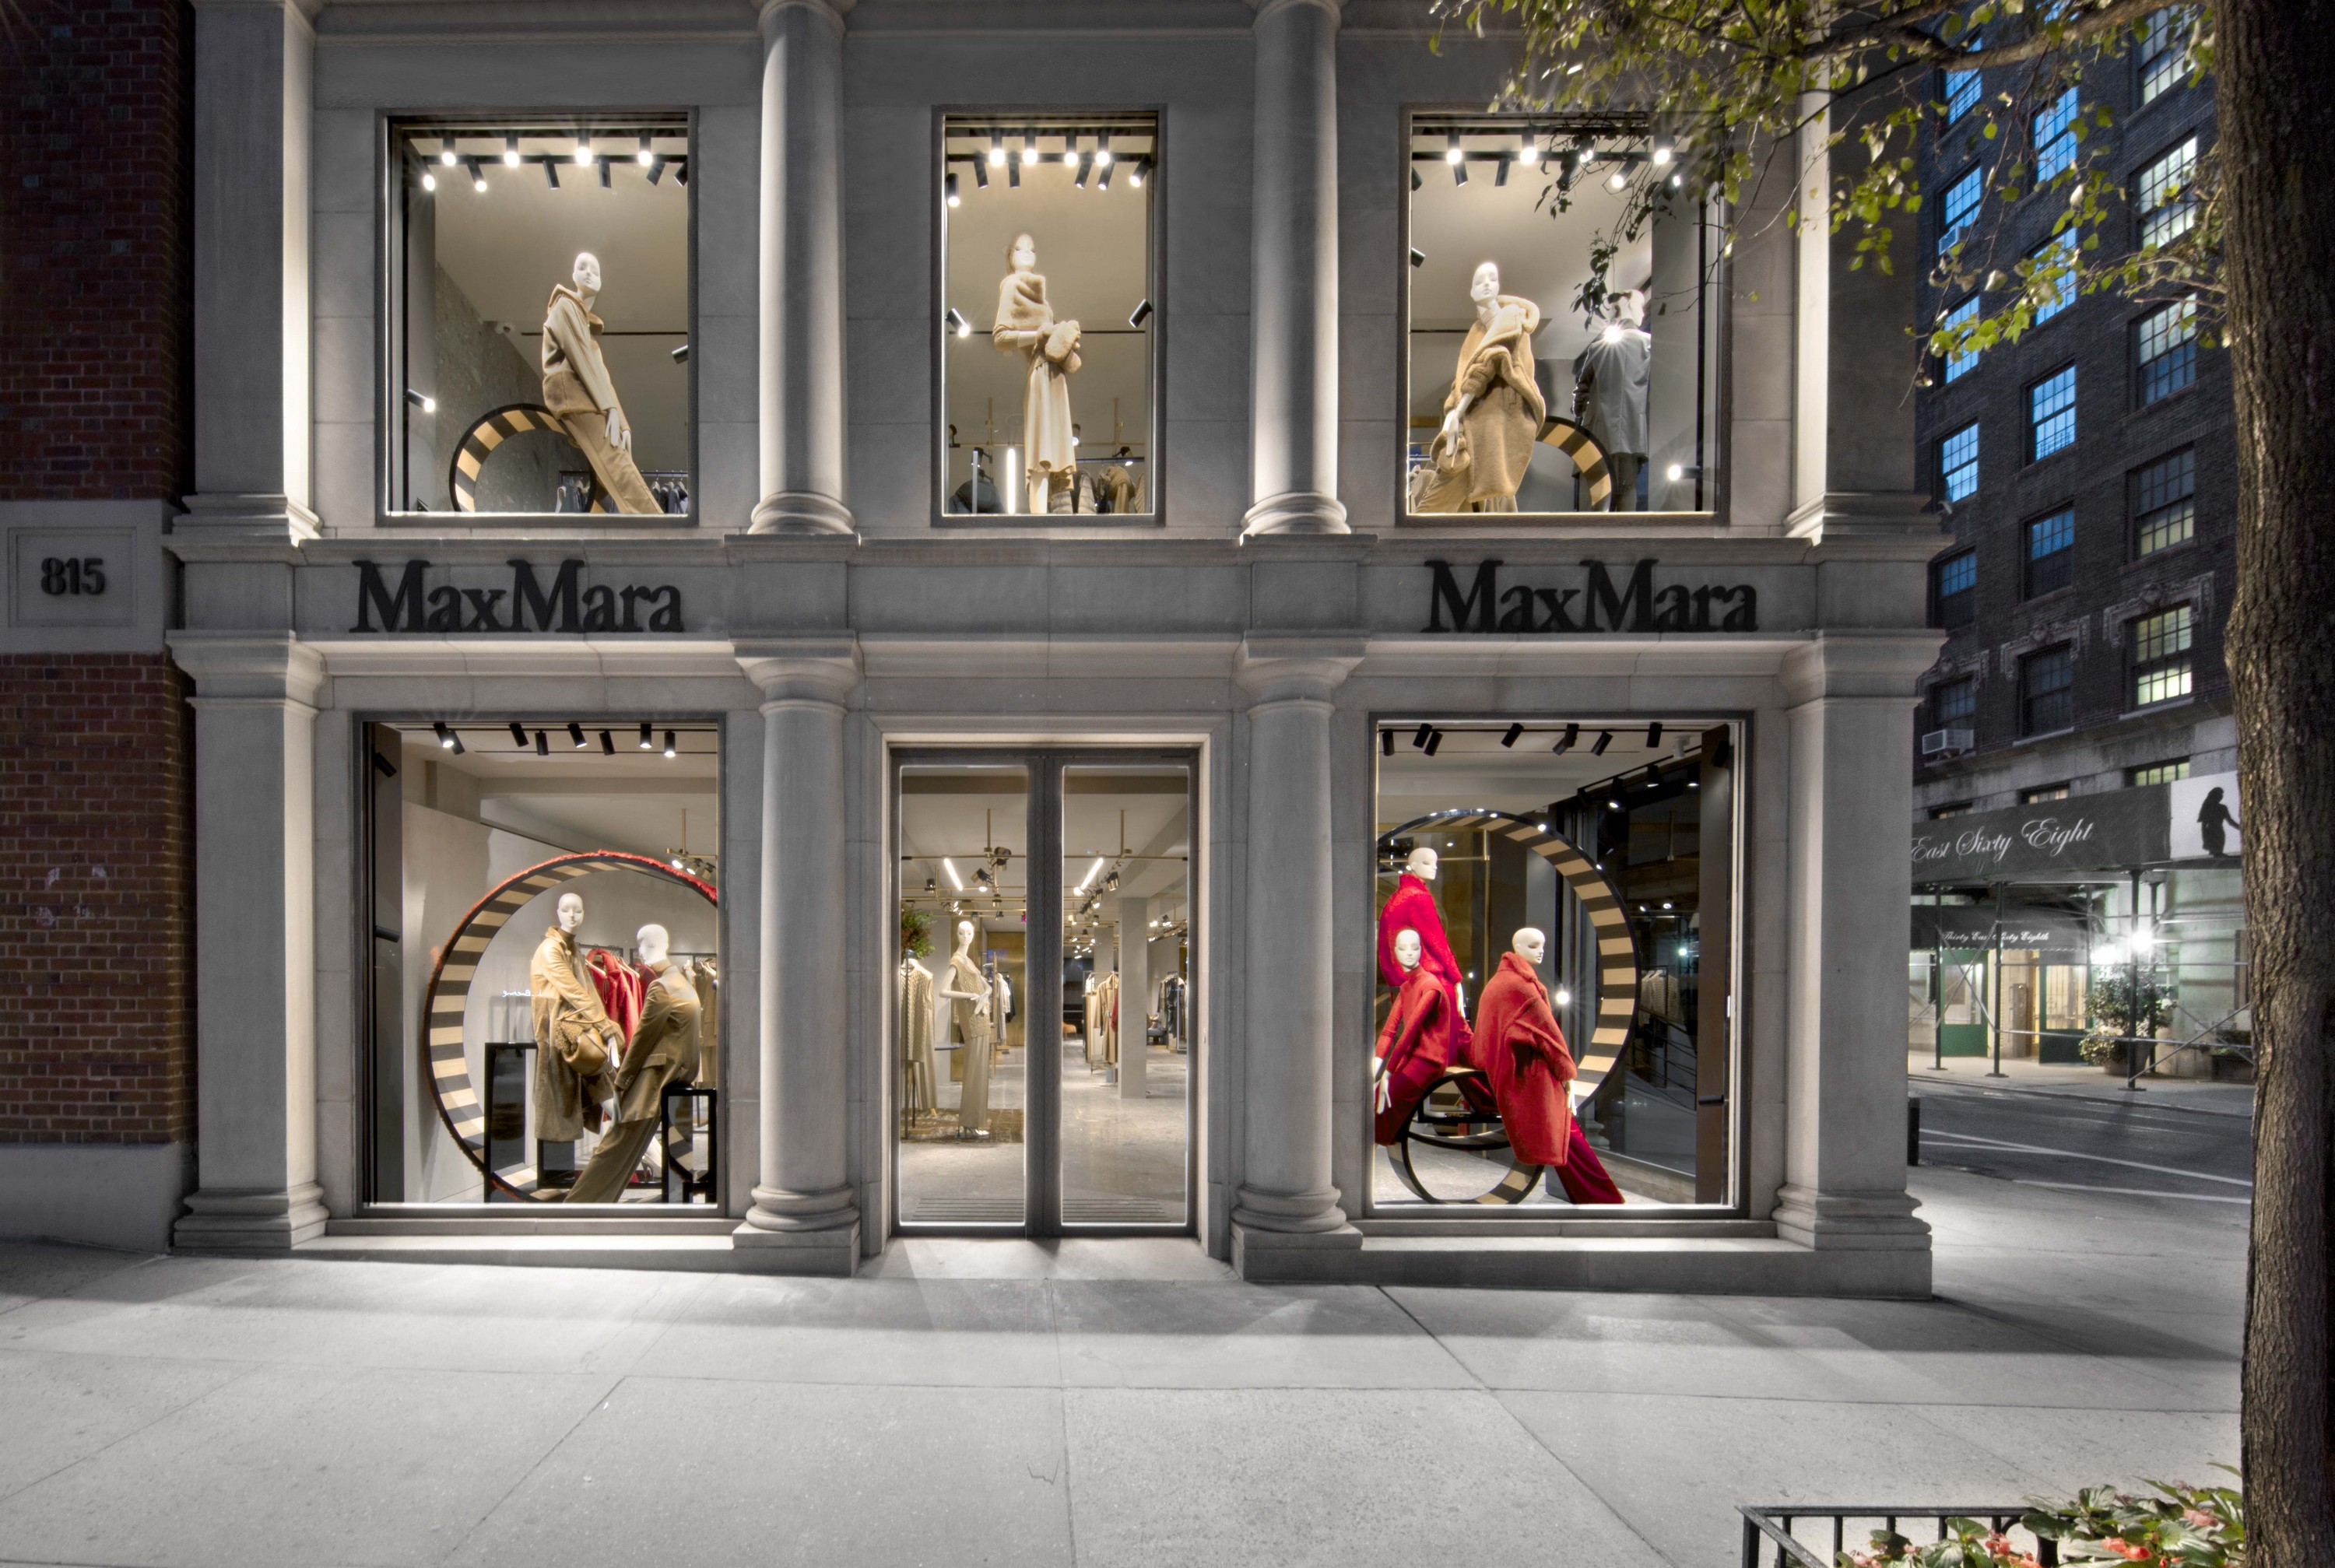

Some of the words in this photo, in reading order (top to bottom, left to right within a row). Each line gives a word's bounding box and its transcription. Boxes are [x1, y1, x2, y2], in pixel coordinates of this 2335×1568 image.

[41, 557, 106, 595] 815
[349, 559, 684, 633] MaxMara
[1420, 559, 1759, 633] MaxMara
[1912, 836, 1951, 864] East
[1956, 826, 2013, 863] Sixty
[2021, 818, 2094, 857] Eight
[1943, 931, 1969, 943] Thirty
[1972, 931, 1990, 941] Eas
[2021, 931, 2049, 943] Eighth
